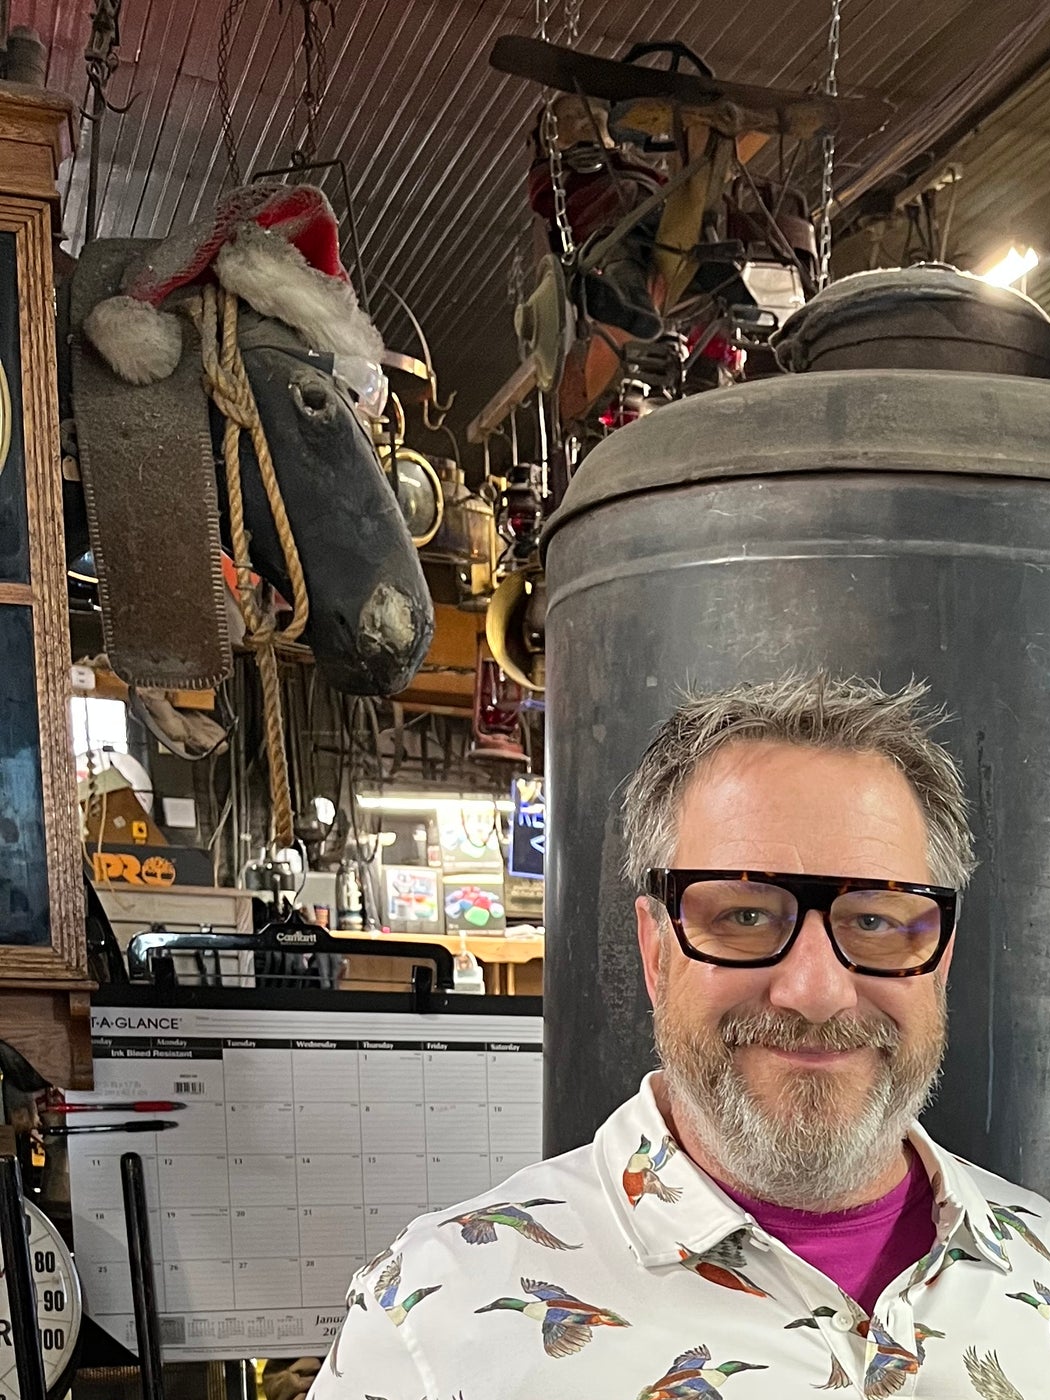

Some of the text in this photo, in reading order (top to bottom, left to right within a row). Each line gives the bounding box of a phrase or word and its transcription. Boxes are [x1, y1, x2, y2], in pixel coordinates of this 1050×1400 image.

[157, 1039, 188, 1048] Monday
[227, 1039, 257, 1049] Tuesday
[296, 1040, 337, 1050] Wednesday
[363, 1041, 394, 1051] Thursday
[427, 1042, 448, 1051] Friday
[490, 1044, 521, 1053] Saturday
[111, 1050, 193, 1059] Ink Bleed Resistant
[35, 1251, 55, 1273] 80
[43, 1290, 65, 1312] 90
[323, 1326, 339, 1337] 20
